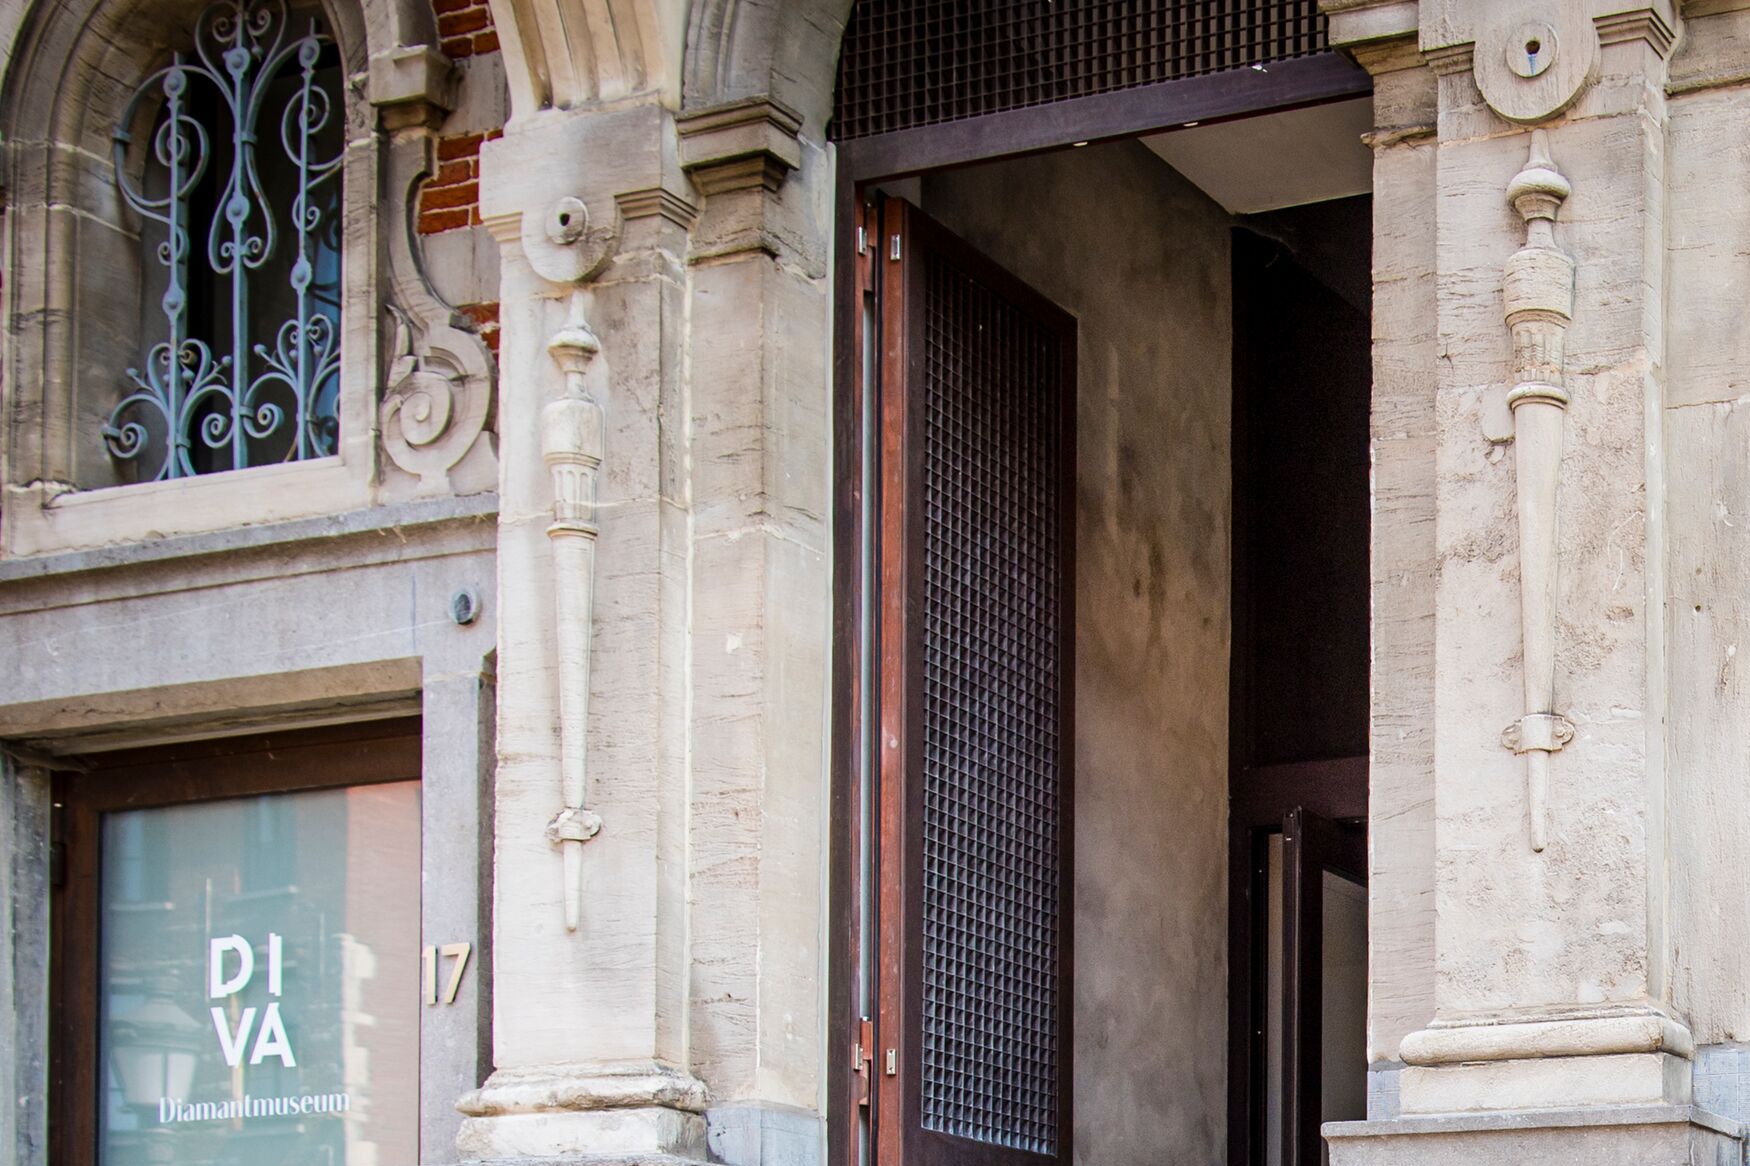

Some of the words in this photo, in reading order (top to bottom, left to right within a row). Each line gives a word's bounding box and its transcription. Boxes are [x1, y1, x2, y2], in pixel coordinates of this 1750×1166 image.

[210, 932, 282, 999] DI
[422, 942, 472, 1006] 17
[209, 1002, 297, 1068] VA
[159, 1092, 350, 1124] Diamantmuseum
